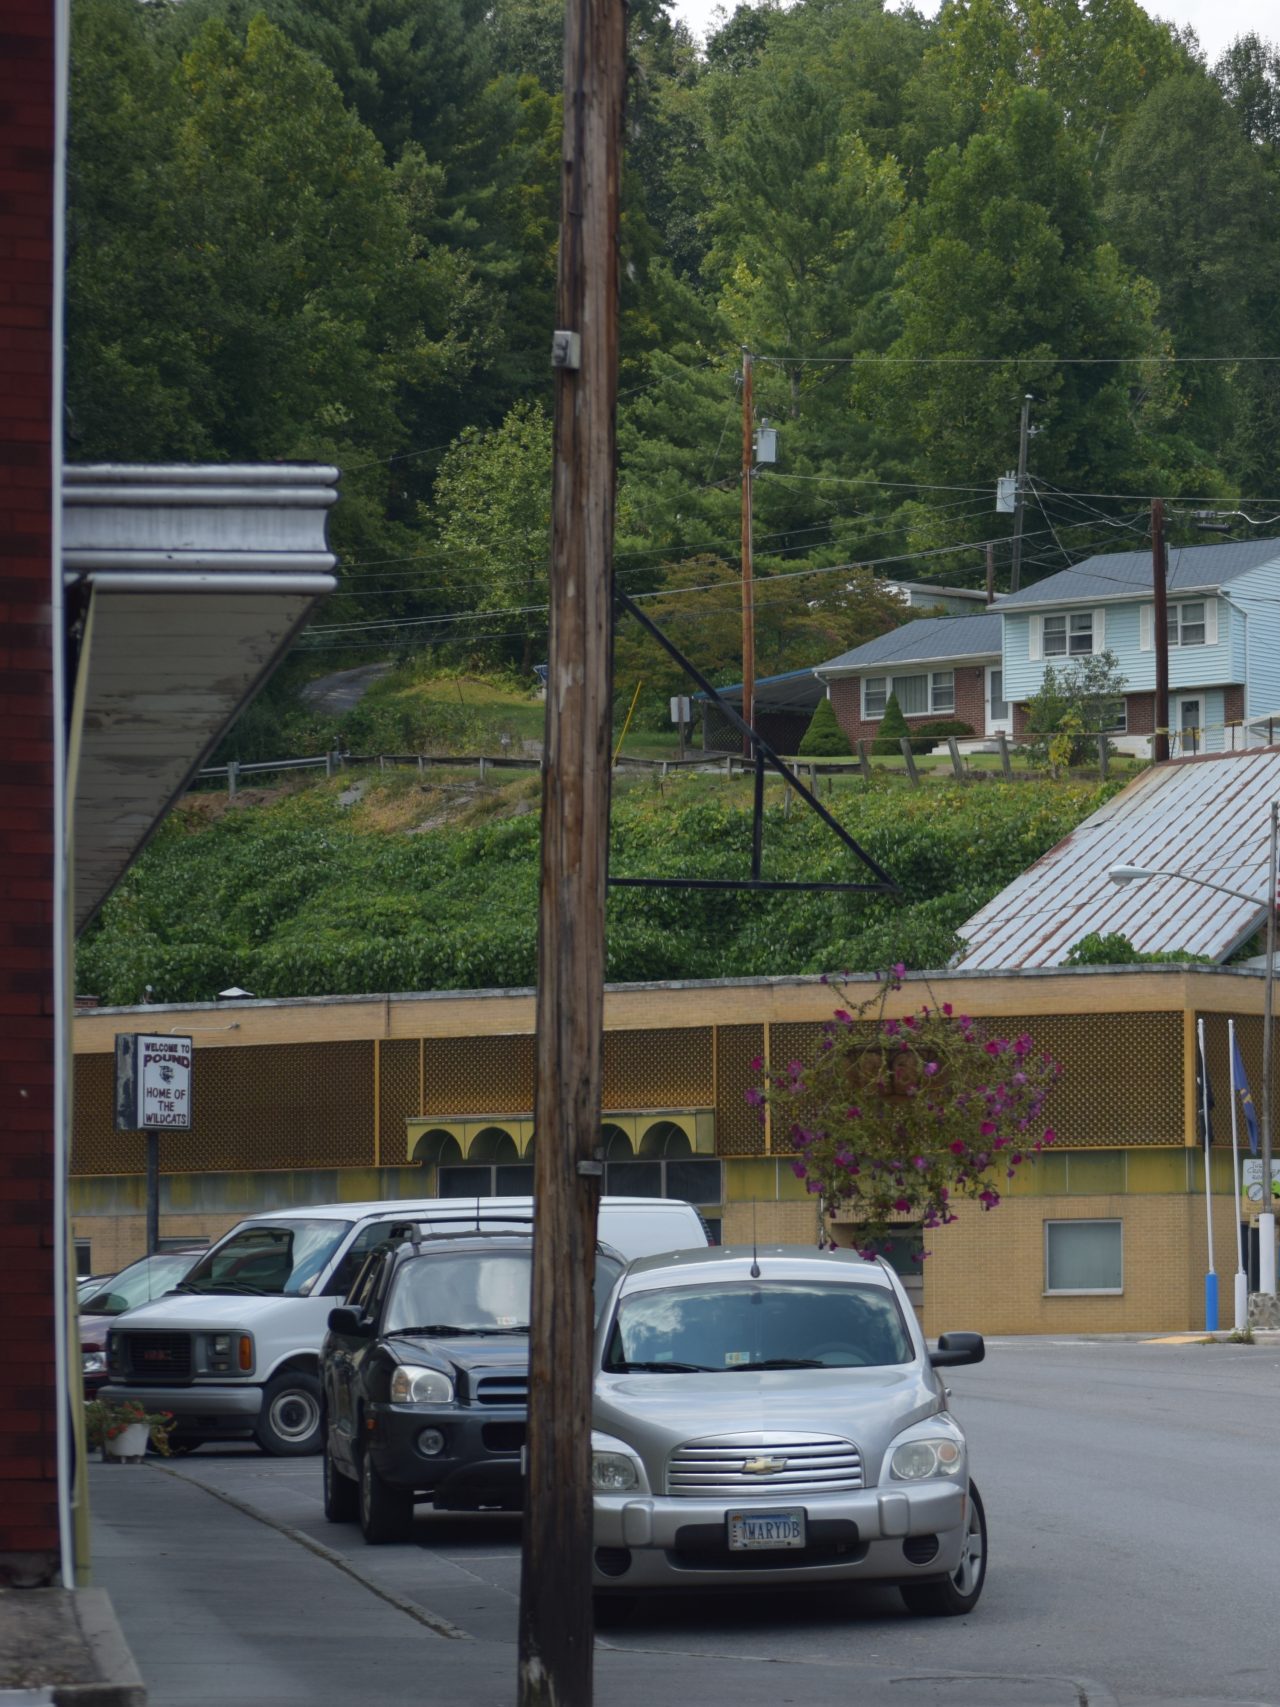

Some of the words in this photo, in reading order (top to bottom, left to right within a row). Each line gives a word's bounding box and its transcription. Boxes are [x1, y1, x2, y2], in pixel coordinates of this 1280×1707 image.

[144, 1042, 178, 1053] WELCOME
[181, 1044, 190, 1054] TO
[143, 1053, 190, 1069] POUND
[146, 1087, 172, 1099] HOME
[174, 1089, 186, 1100] OF
[157, 1100, 175, 1112] THE
[145, 1113, 187, 1125] WILDCATS
